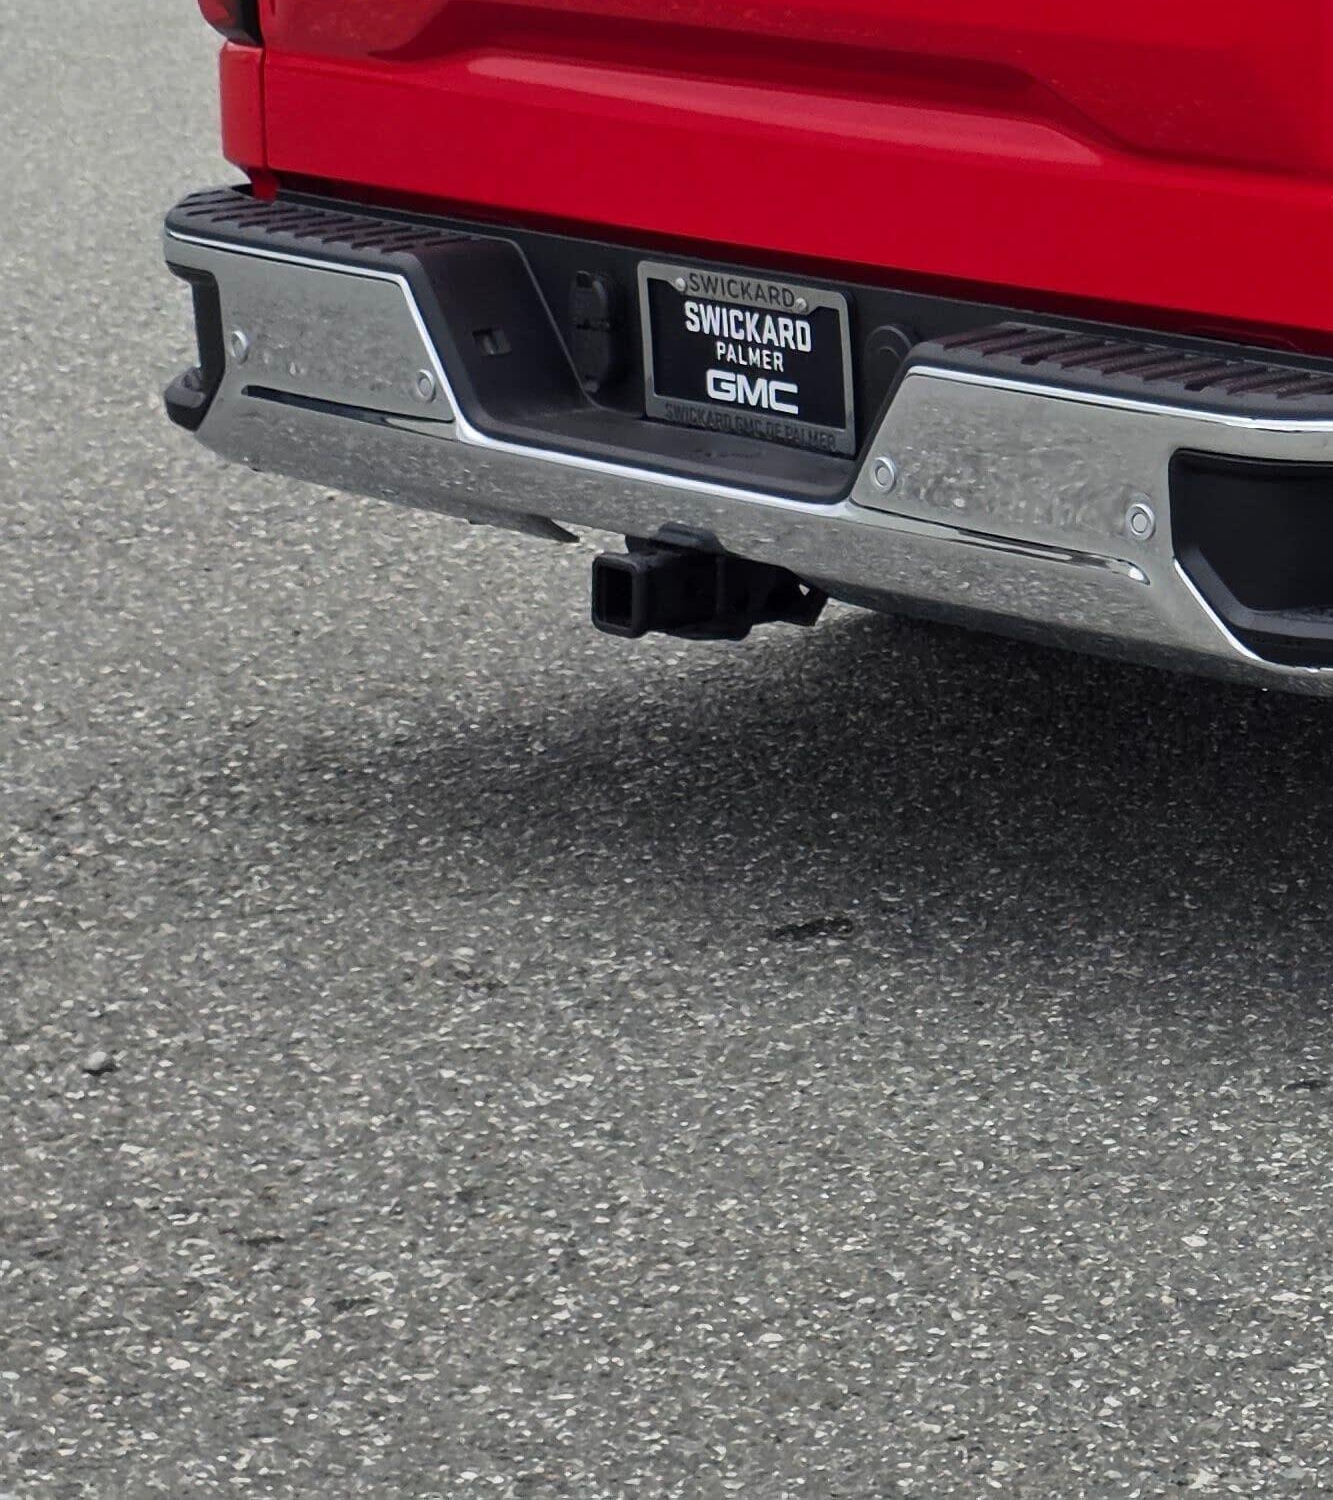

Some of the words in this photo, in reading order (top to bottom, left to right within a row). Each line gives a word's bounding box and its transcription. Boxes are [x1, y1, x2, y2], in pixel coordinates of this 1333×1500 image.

[688, 272, 796, 309] SWICKARD
[683, 301, 812, 353] SWICKARD
[716, 341, 784, 372] PALMER
[706, 368, 799, 415] GMC
[664, 402, 734, 431] SWICKARD
[785, 423, 837, 450] PALMER
